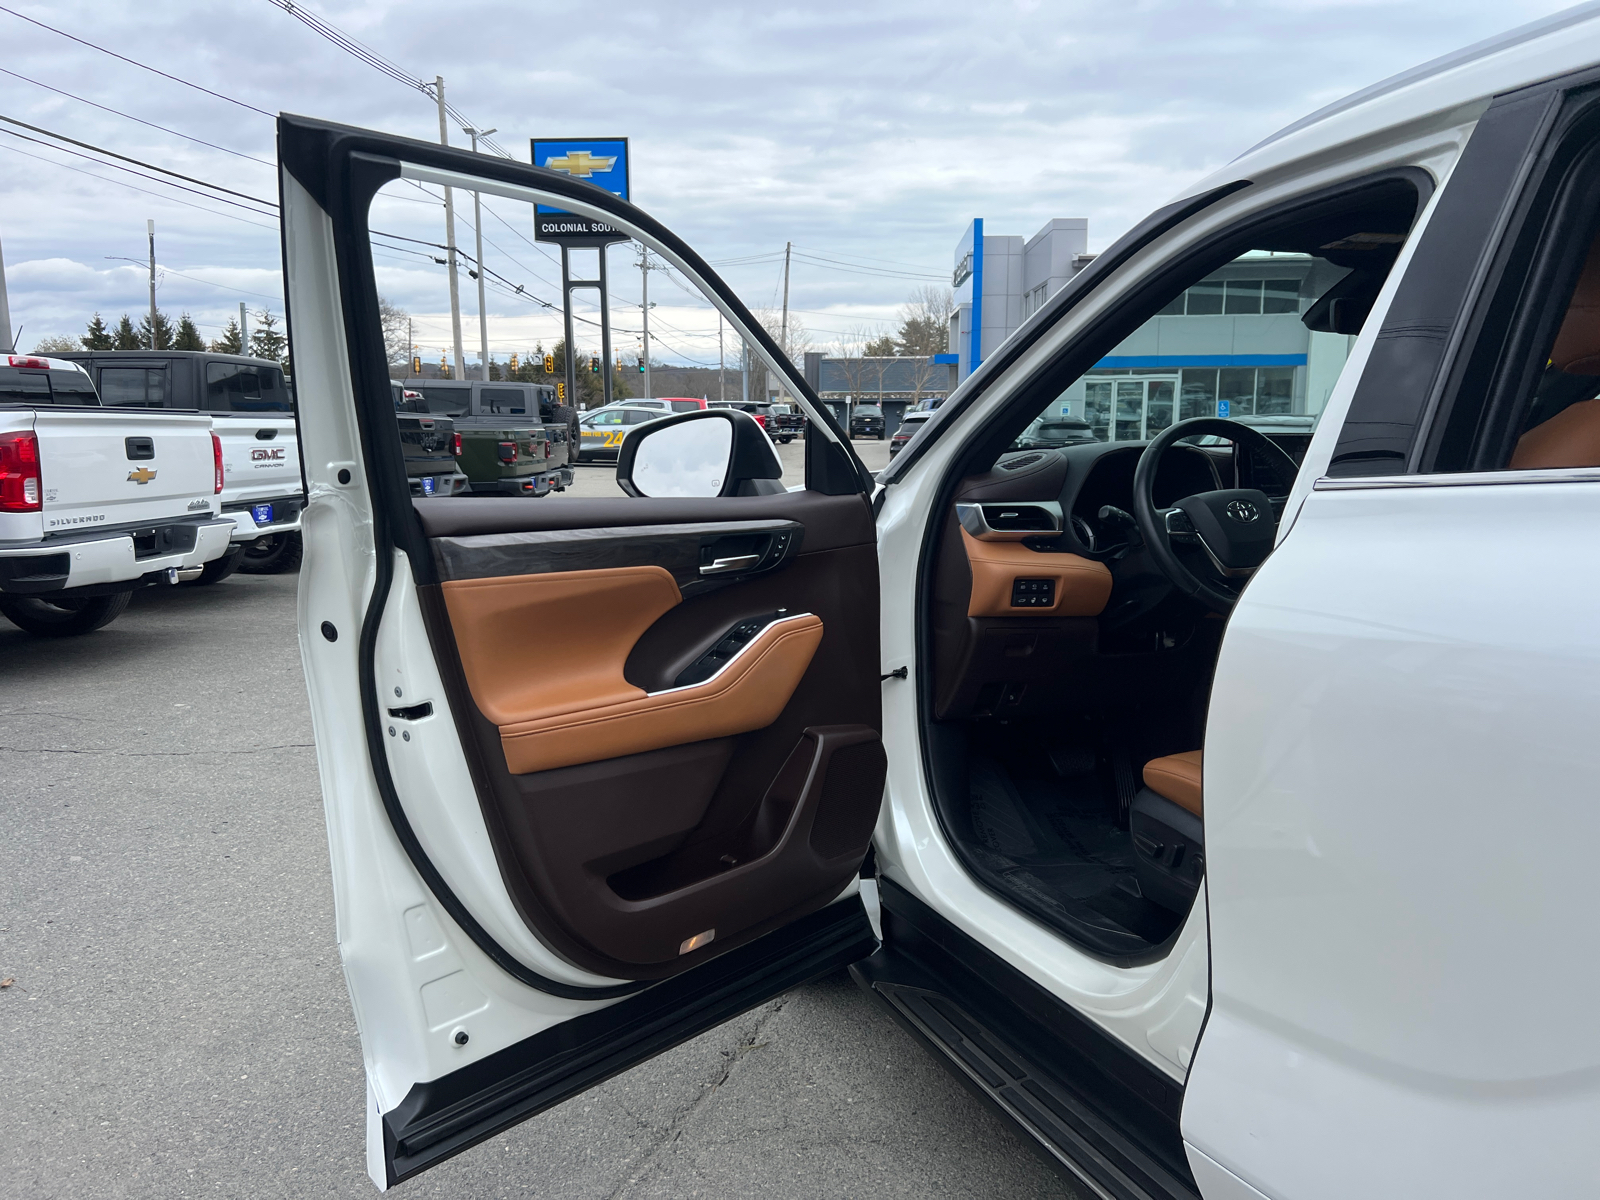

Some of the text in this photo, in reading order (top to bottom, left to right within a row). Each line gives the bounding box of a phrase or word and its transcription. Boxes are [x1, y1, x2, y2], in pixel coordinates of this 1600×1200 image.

[541, 223, 619, 232] COLONIAL SOU
[251, 449, 285, 461] GMC
[50, 514, 105, 527] SILVERADO
